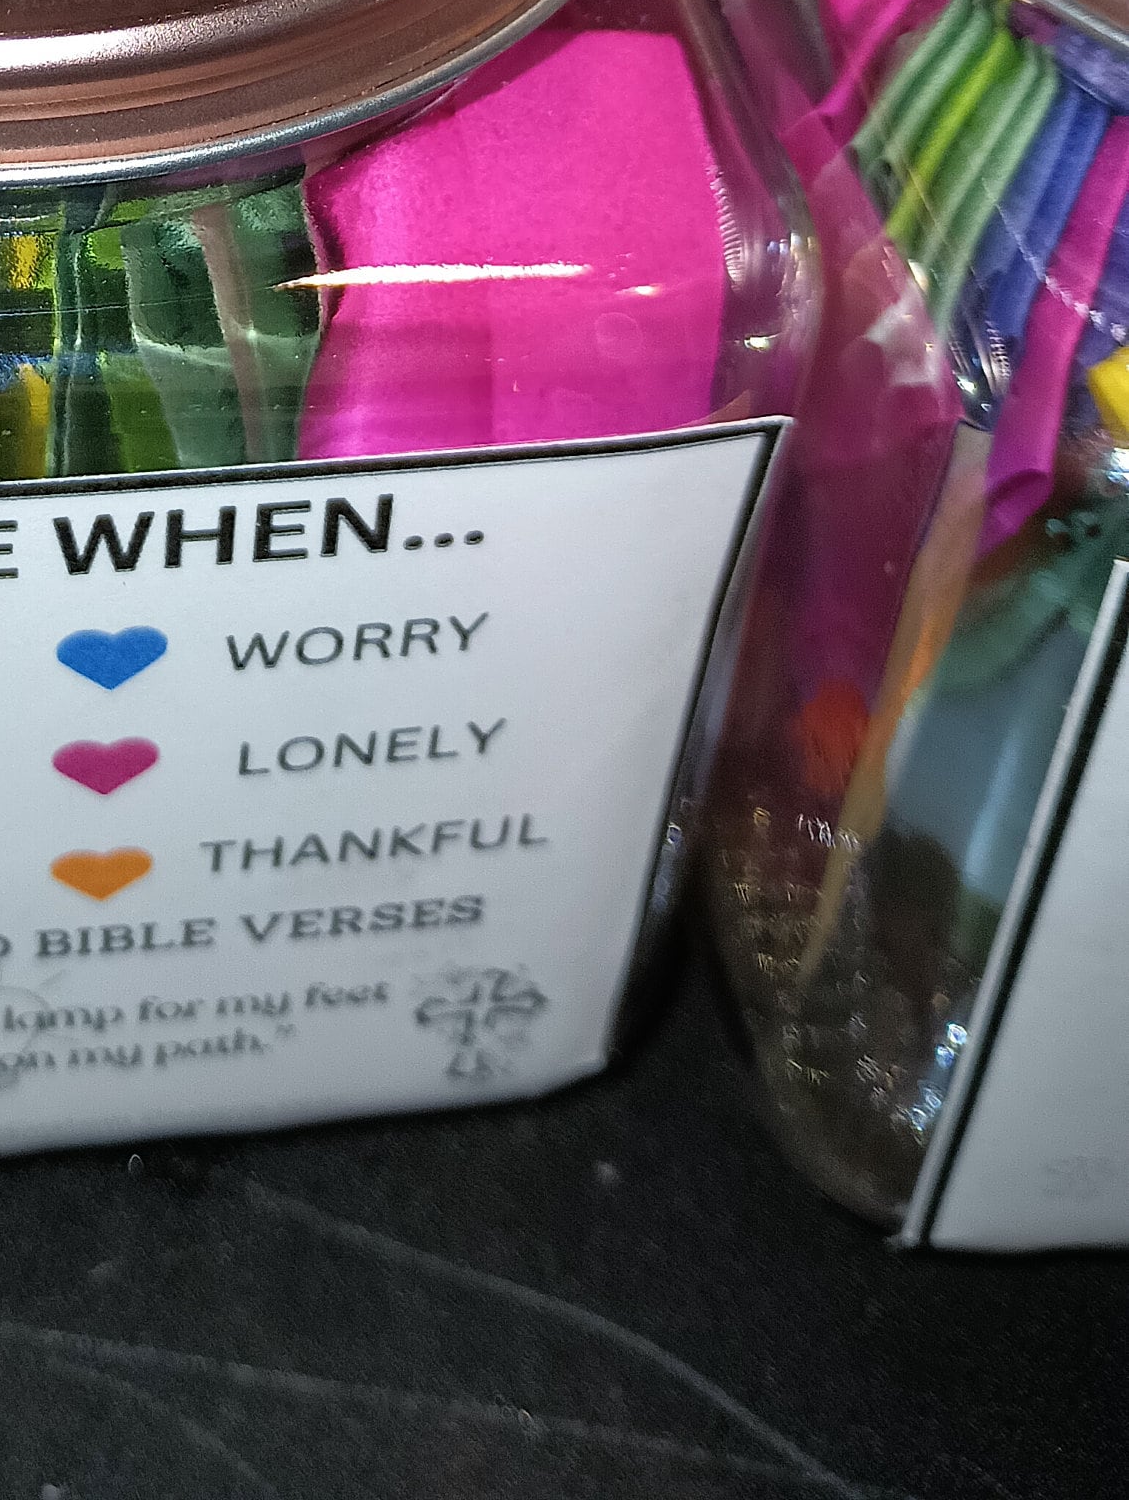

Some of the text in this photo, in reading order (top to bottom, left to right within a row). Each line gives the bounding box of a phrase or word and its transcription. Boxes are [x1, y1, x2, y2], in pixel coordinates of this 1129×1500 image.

[52, 494, 485, 576] WHEN...
[226, 612, 489, 670] WORRY
[237, 717, 506, 777] LONELY
[199, 813, 550, 873] THANKFUL
[36, 918, 217, 959] BIBLE
[239, 896, 485, 944] VERSES
